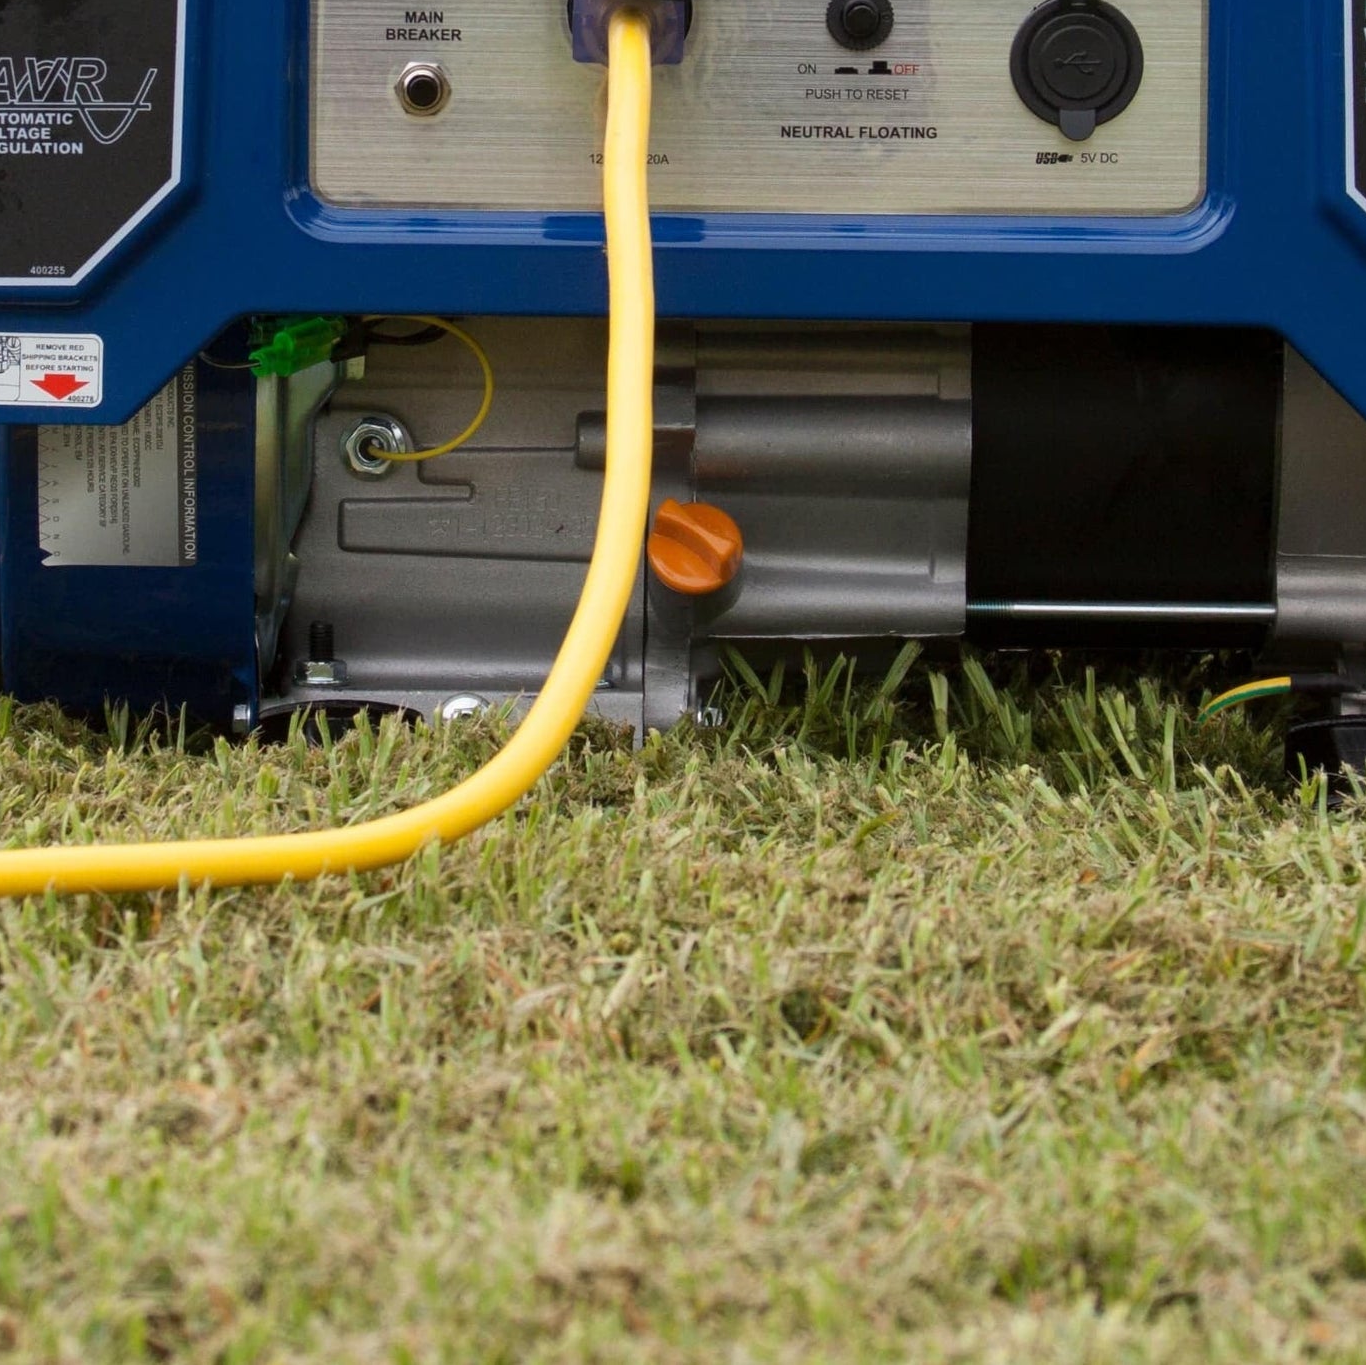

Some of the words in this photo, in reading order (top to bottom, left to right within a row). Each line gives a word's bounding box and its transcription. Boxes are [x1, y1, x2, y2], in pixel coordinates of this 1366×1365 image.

[405, 12, 444, 23] MAIN
[386, 29, 462, 41] BREAKER
[797, 64, 817, 74] ON
[894, 64, 920, 74] OFF
[805, 89, 841, 100] PUSH
[845, 89, 862, 100] TO
[866, 89, 909, 100] RESET
[780, 126, 854, 139] NEUTRAL
[859, 126, 938, 139] FLOATING
[1080, 153, 1096, 163] 5V
[1100, 153, 1118, 163] DC
[30, 266, 65, 275] 400255
[57, 364, 94, 372] STARTING
[182, 366, 194, 412] ISSION
[183, 416, 195, 476] CONTROL
[121, 447, 129, 477] OPERATE
[122, 478, 129, 488] ON
[184, 478, 196, 560] INFORMATION
